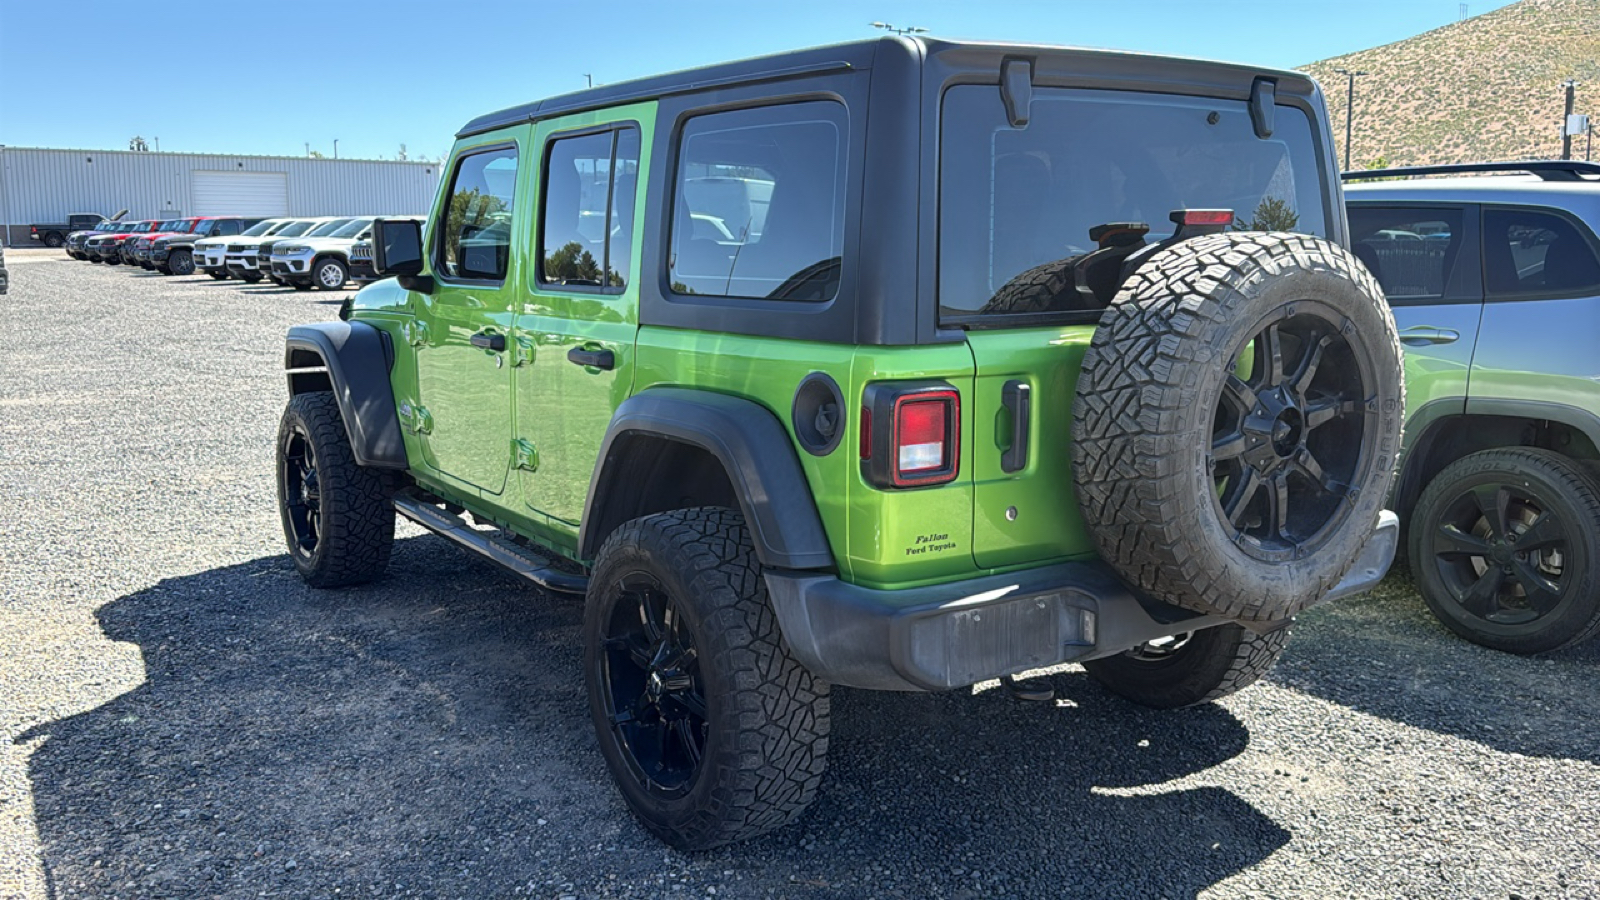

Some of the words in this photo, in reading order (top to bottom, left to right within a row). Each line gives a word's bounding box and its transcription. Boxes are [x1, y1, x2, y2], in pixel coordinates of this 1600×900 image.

[915, 533, 949, 544] Fallon
[905, 545, 926, 556] Ford
[928, 541, 957, 552] Toyota
